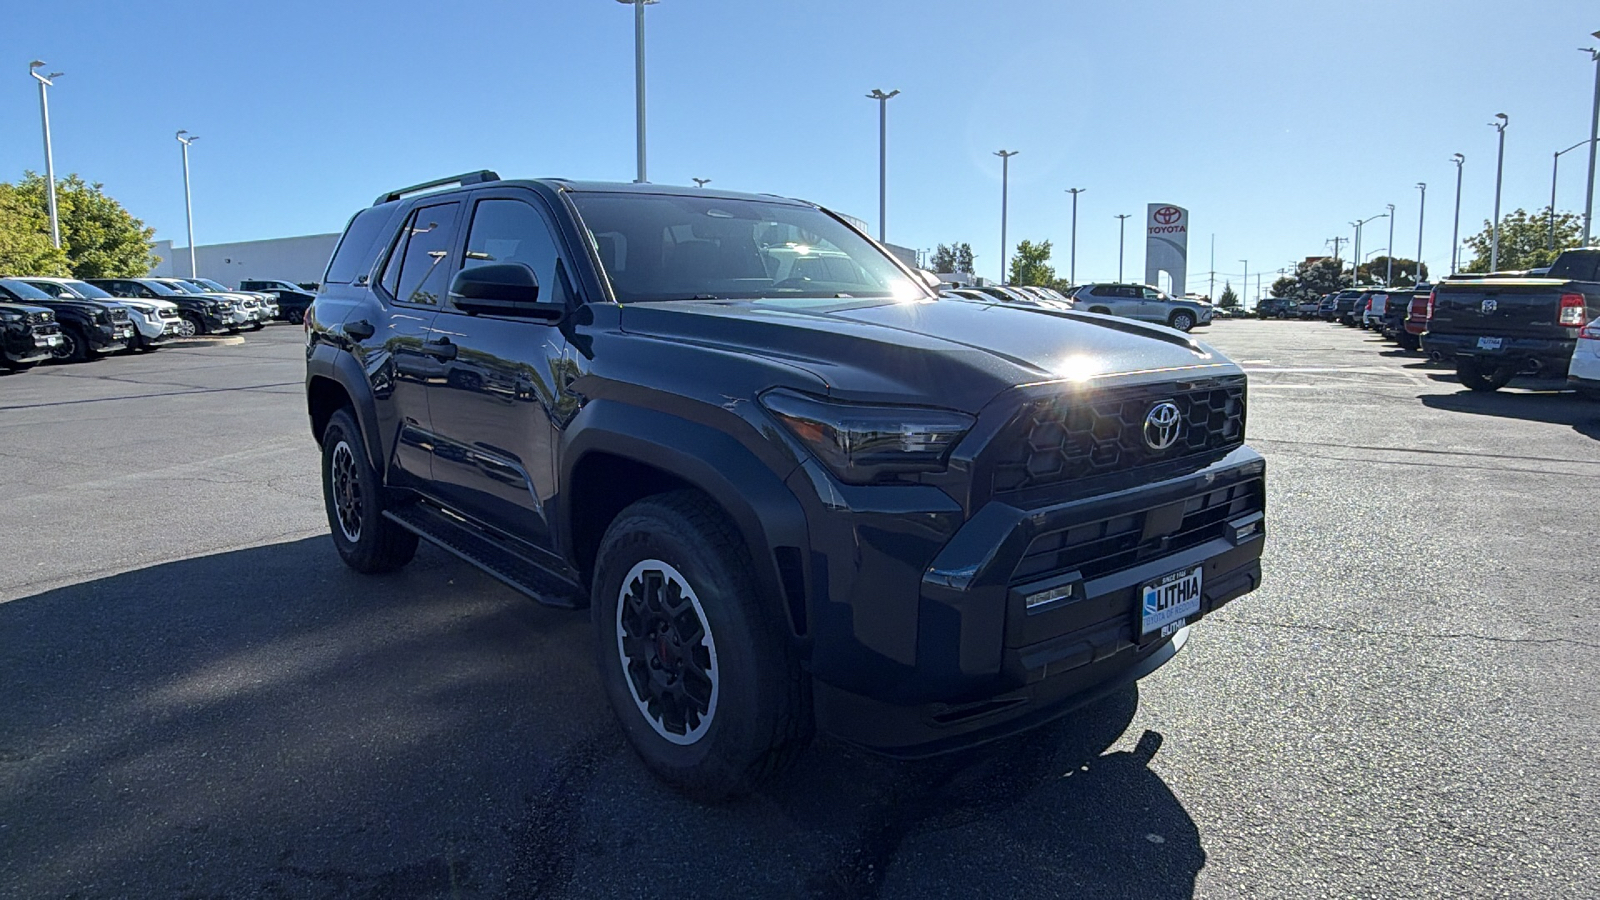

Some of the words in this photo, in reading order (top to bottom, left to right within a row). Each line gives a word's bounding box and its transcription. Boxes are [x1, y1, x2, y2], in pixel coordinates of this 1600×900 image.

[1148, 225, 1186, 235] TOYOTA
[1157, 576, 1199, 612] LITHIA
[1144, 612, 1166, 626] TOYOTA
[1166, 608, 1174, 619] OF
[1174, 598, 1199, 614] REDDING
[1167, 617, 1186, 635] LITHIA
